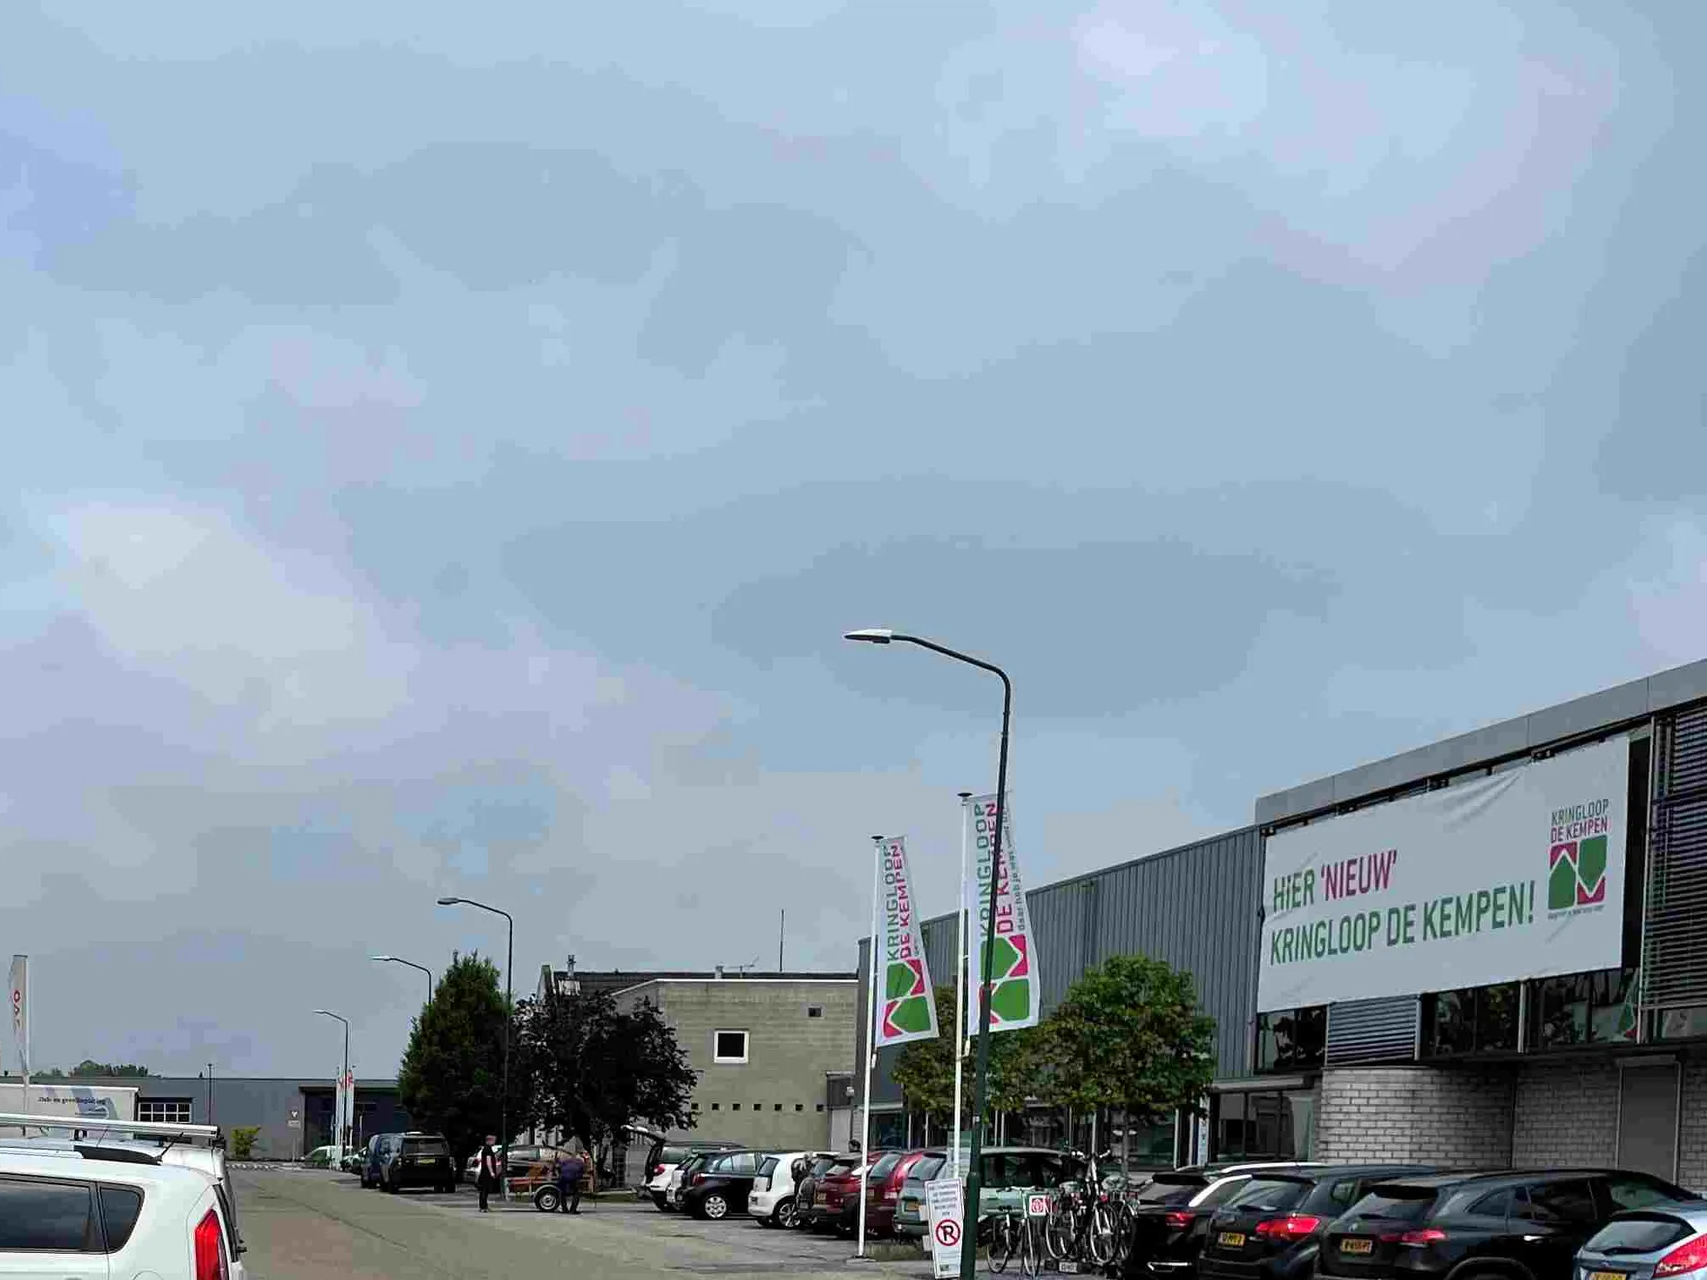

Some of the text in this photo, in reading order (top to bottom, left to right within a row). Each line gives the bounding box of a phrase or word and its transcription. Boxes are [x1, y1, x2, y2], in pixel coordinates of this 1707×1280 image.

[1550, 815, 1608, 843] DE KEMPEN
[1551, 798, 1609, 827] KRINGLOOP
[882, 844, 900, 961] KRINGLOOP
[891, 845, 912, 959] DE KEMPEN
[1273, 868, 1315, 913] HIER
[996, 904, 1014, 934] DE
[1270, 880, 1536, 966] KRINGLOOP DE KEMPEN!
